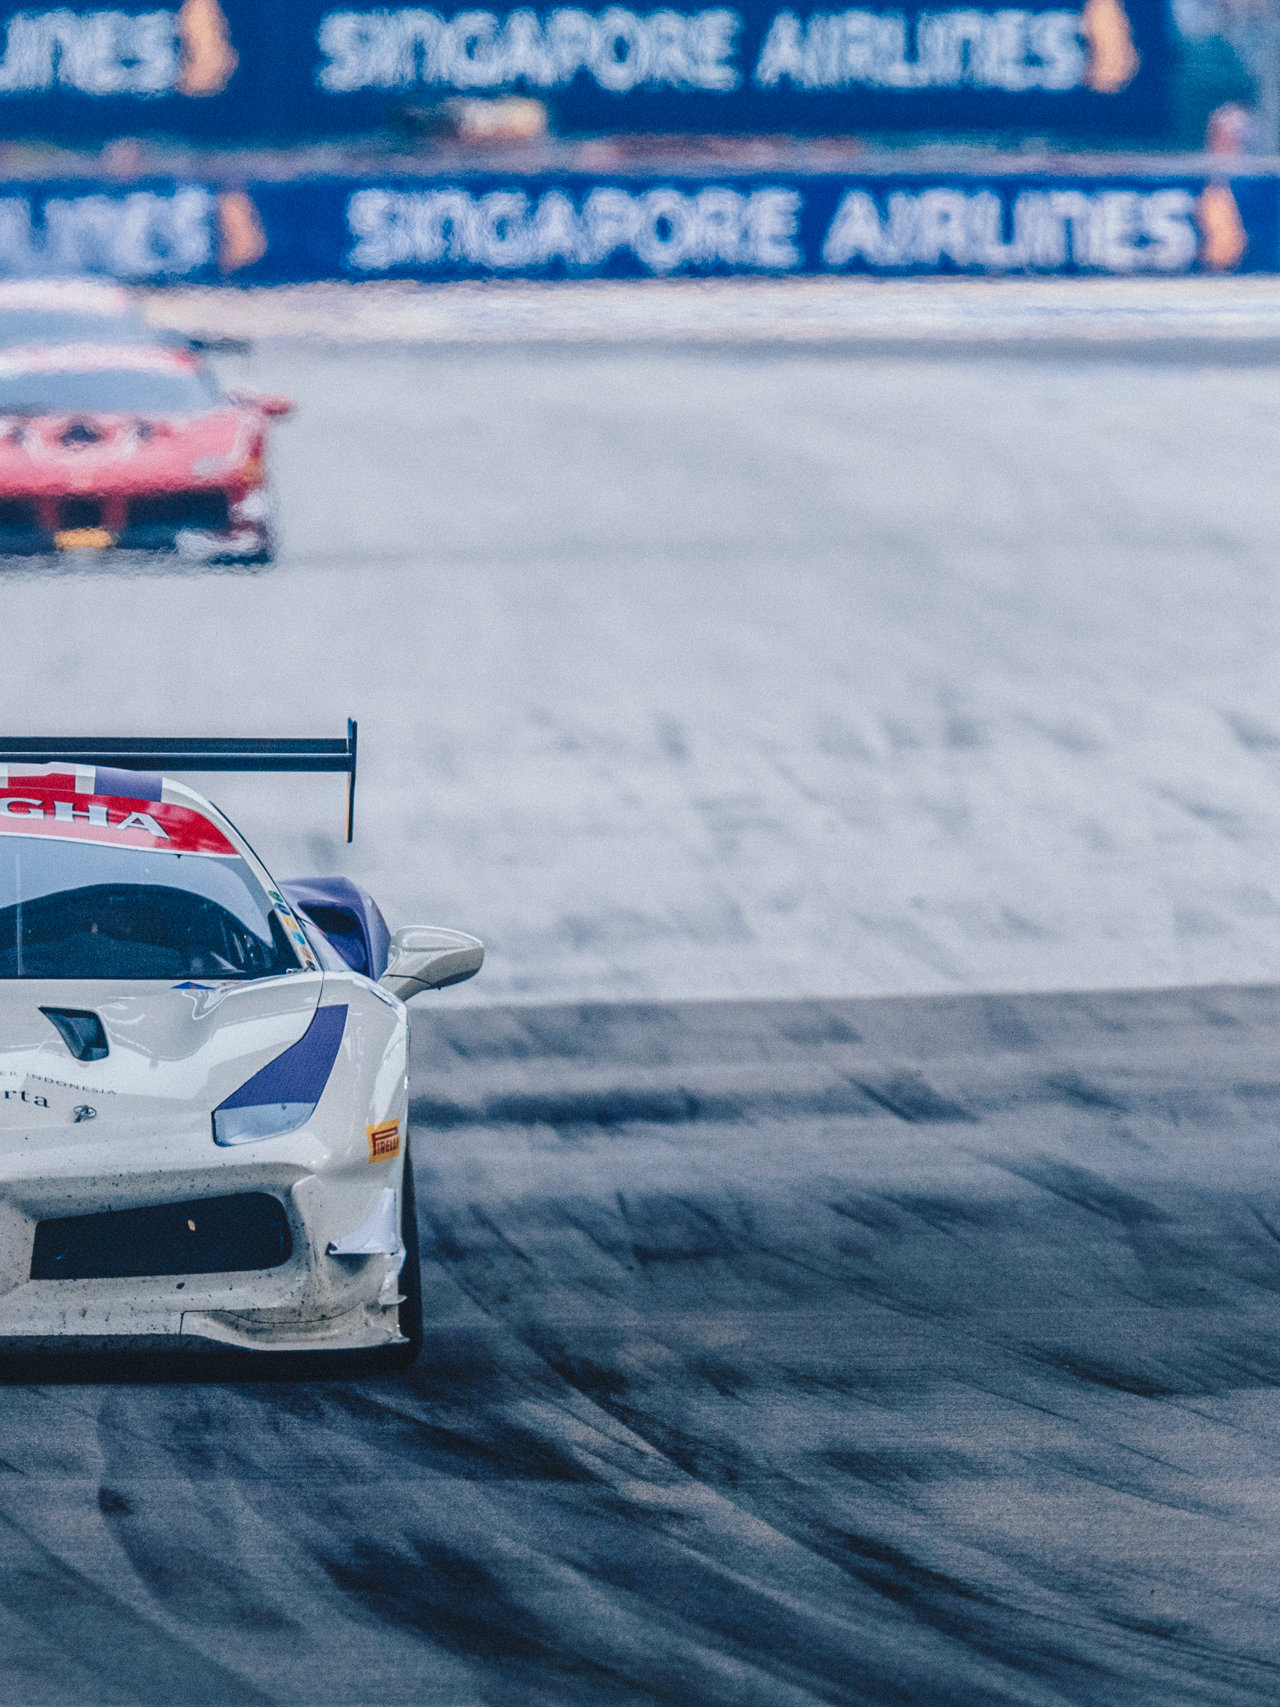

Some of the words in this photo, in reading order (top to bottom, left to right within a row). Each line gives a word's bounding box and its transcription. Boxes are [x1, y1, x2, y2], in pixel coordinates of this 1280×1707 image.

[317, 8, 740, 92] SINGAPORE
[754, 9, 1086, 90] AIRLINES
[346, 187, 802, 272] SINGAPORE
[822, 189, 1197, 272] AIRLINES
[26, 1072, 117, 1096] INDONESIA
[371, 1126, 399, 1156] PIRELLI
